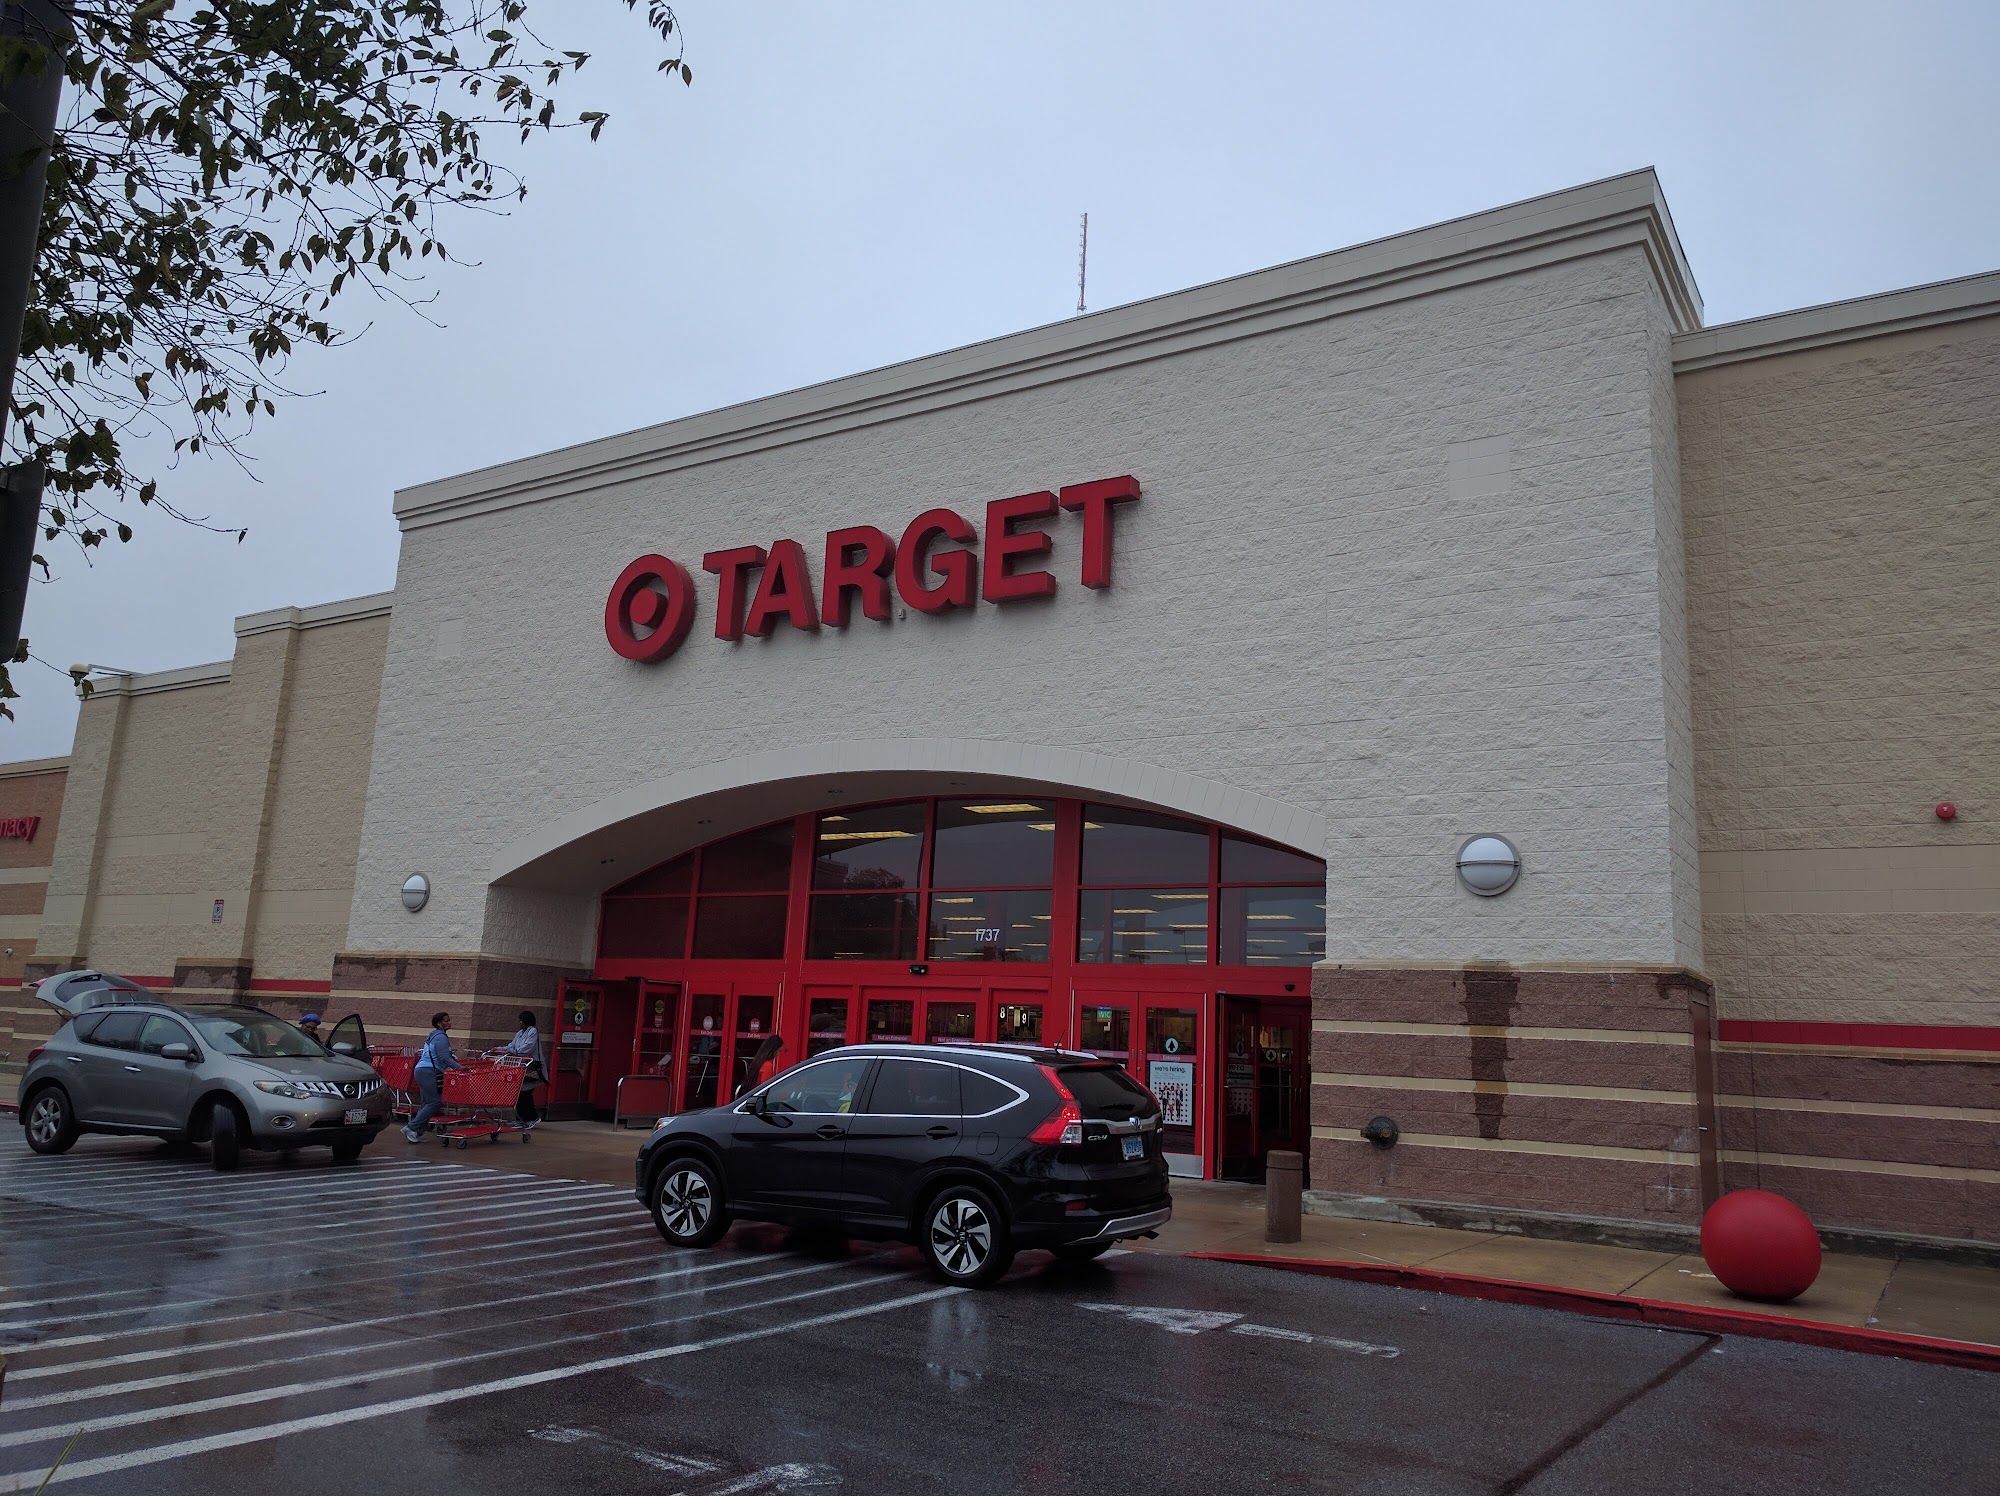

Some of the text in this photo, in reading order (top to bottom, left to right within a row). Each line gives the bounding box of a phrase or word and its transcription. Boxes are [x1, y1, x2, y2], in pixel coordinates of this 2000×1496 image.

[703, 475, 1141, 641] TARGET
[975, 928, 1000, 942] 1737
[999, 1006, 1006, 1019] 8
[1021, 1012, 1027, 1024] 9
[1097, 1009, 1112, 1019] WIC
